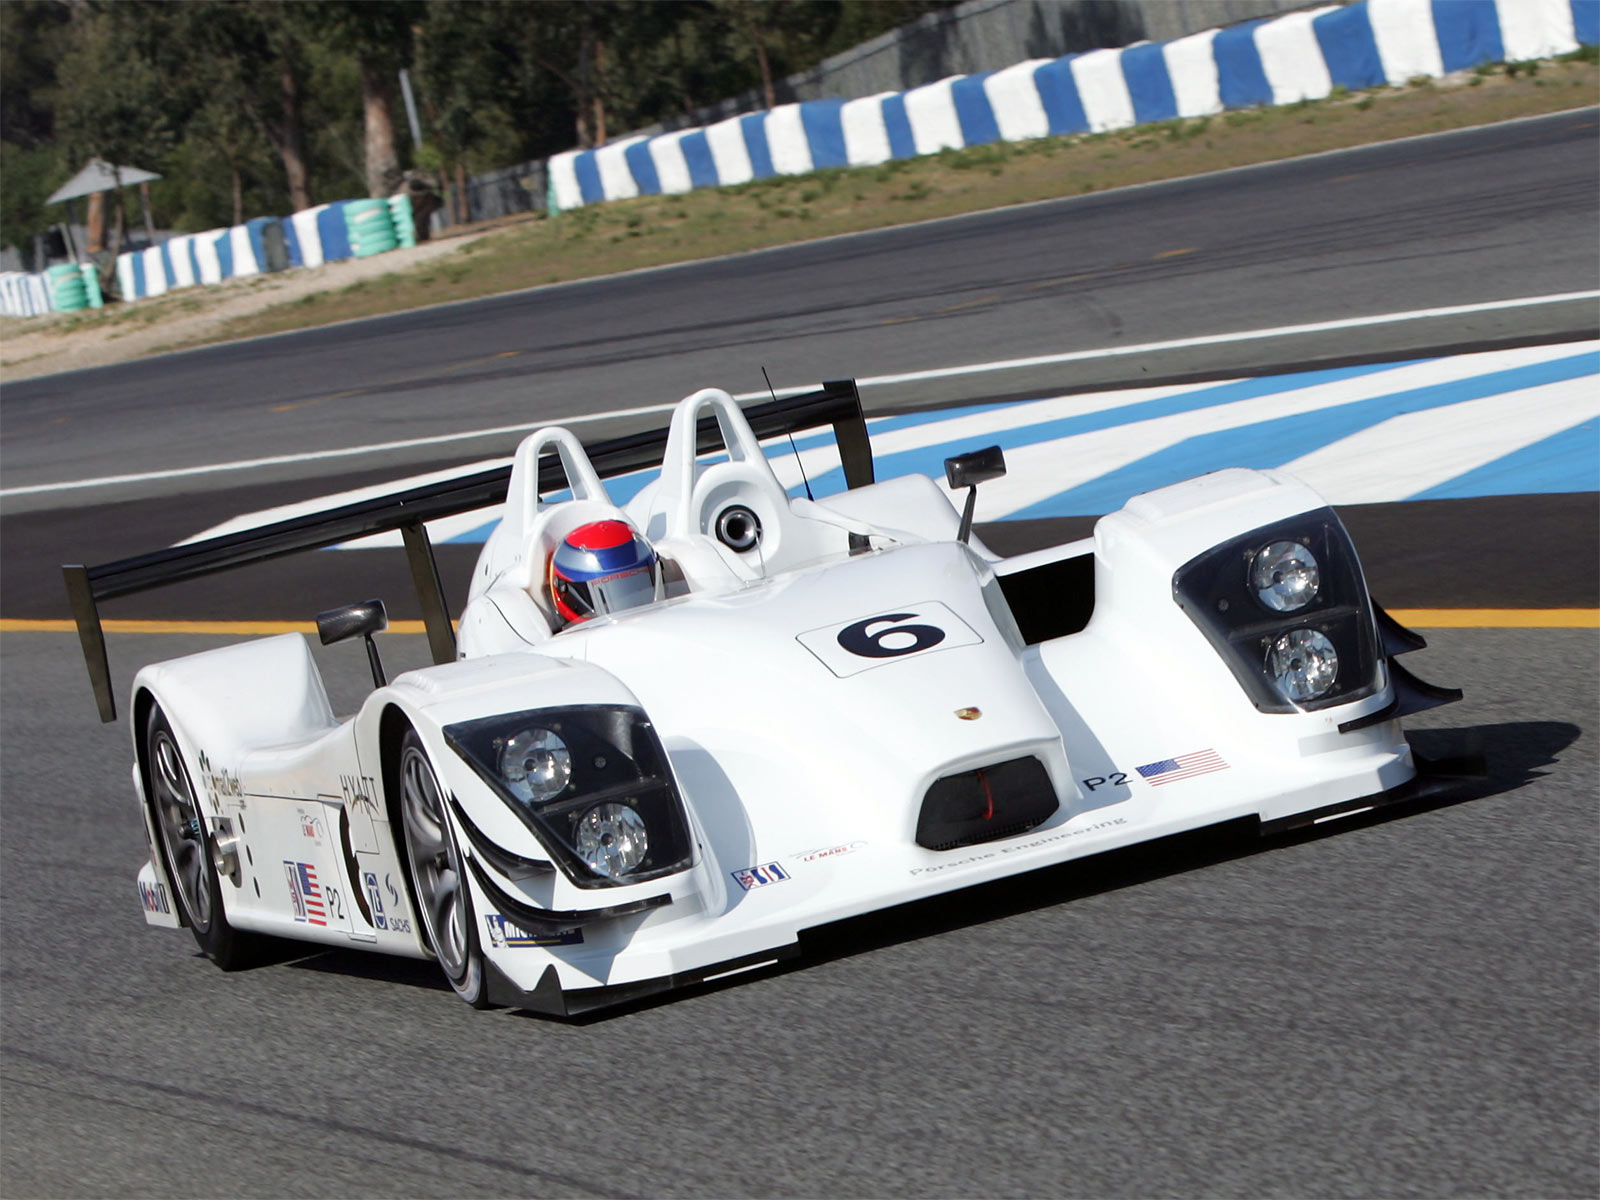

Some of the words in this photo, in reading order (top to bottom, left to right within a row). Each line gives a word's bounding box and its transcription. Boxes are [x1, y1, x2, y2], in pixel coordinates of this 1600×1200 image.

[837, 613, 946, 658] 6
[339, 775, 379, 814] HYATT
[1082, 772, 1133, 791] P2
[909, 852, 996, 876] Porsche
[1001, 817, 1128, 853] Engineering
[325, 885, 345, 920] P2
[389, 917, 411, 934] SACHS
